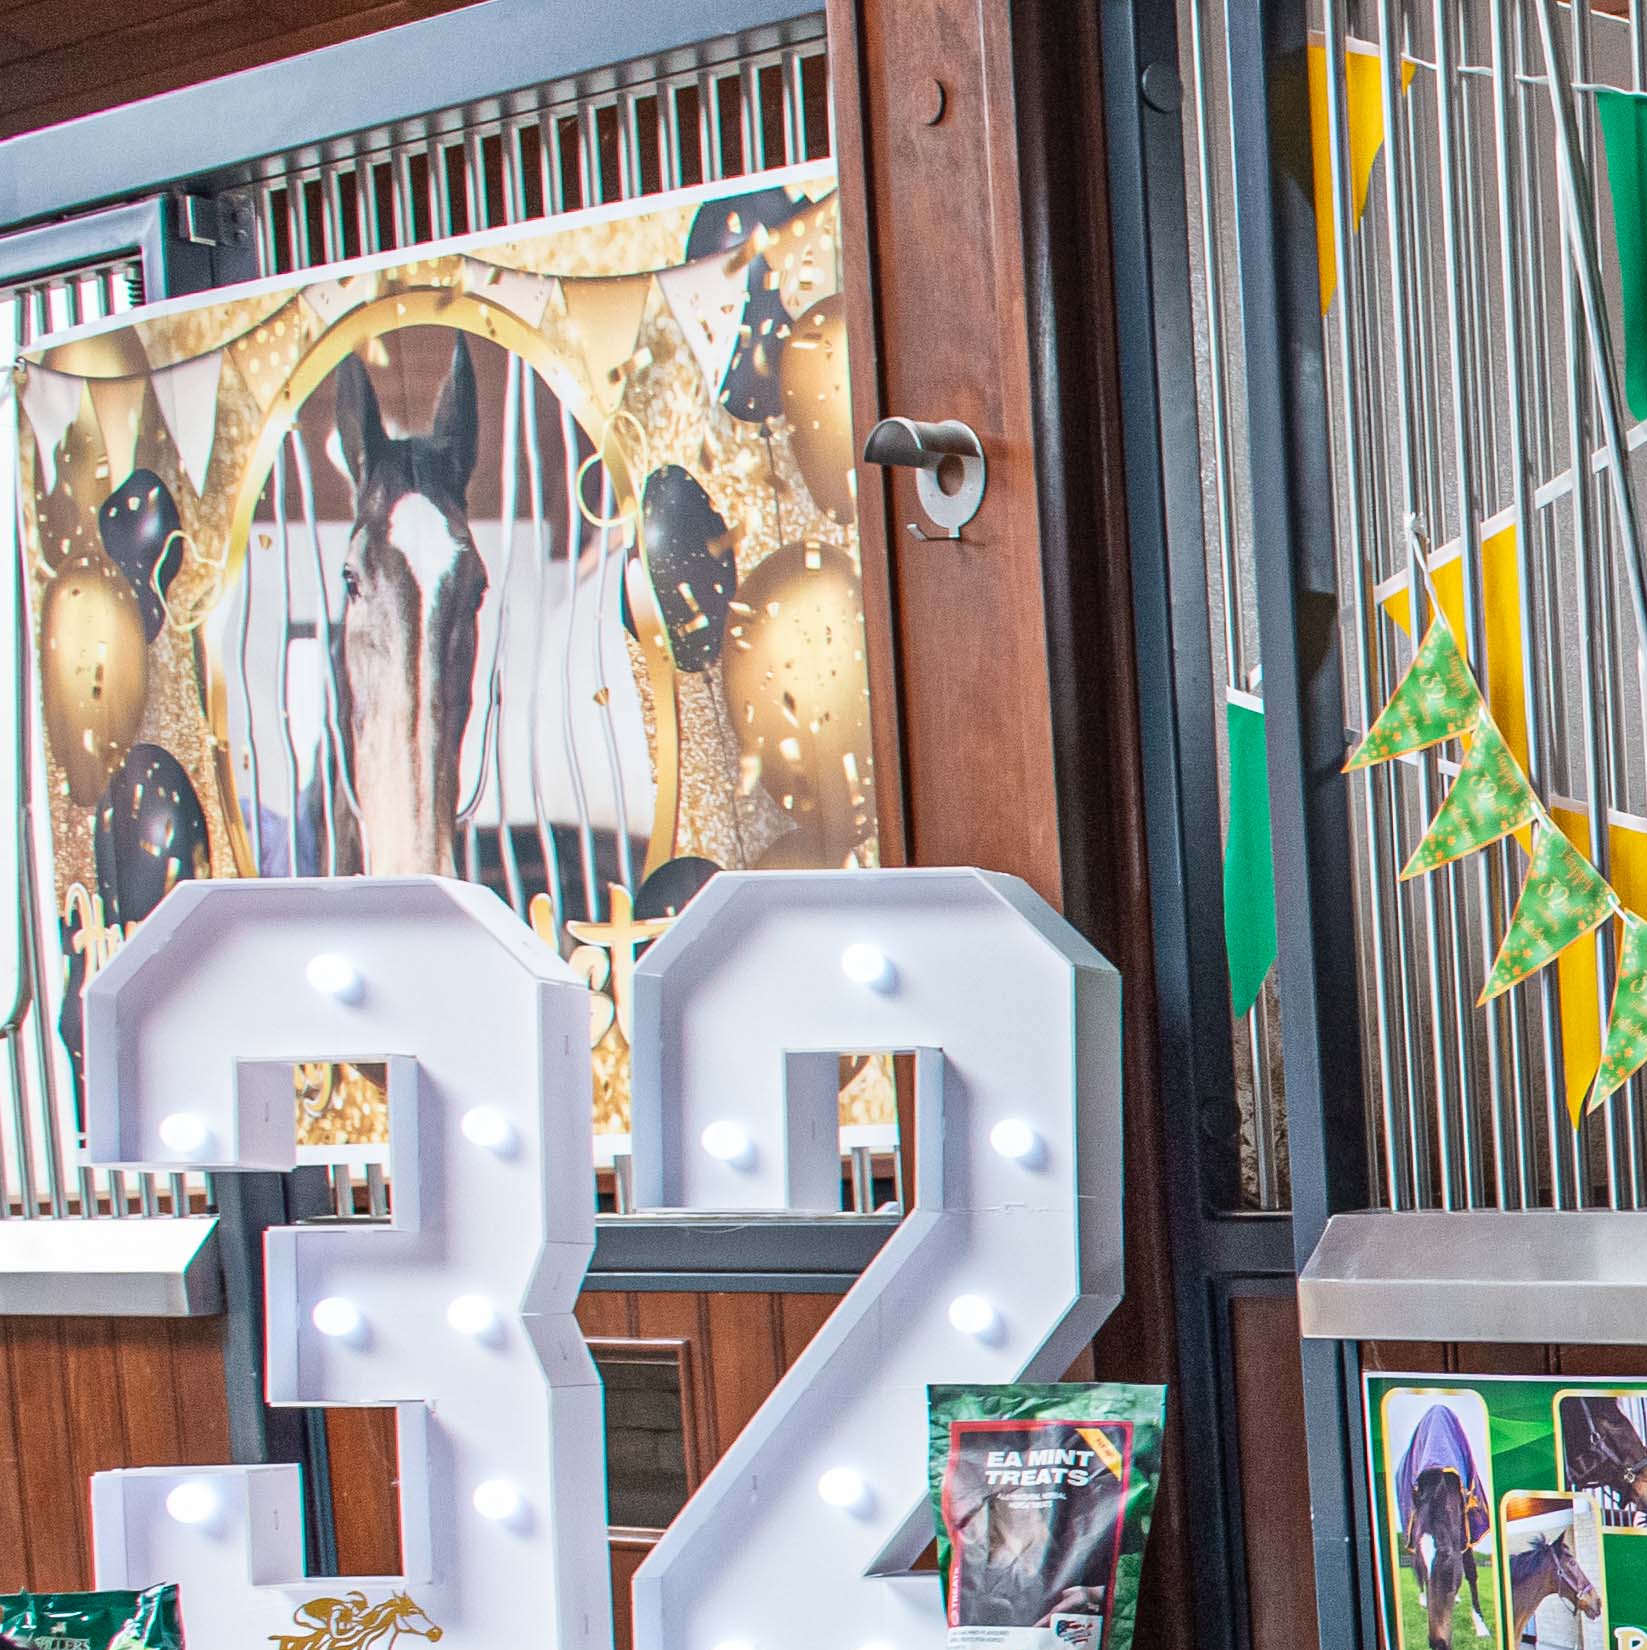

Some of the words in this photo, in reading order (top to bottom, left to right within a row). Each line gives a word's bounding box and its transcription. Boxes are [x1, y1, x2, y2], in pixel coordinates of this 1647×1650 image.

[986, 1450, 1022, 1467] EA
[1027, 1448, 1095, 1467] MINT
[985, 1467, 1090, 1487] TREATS
